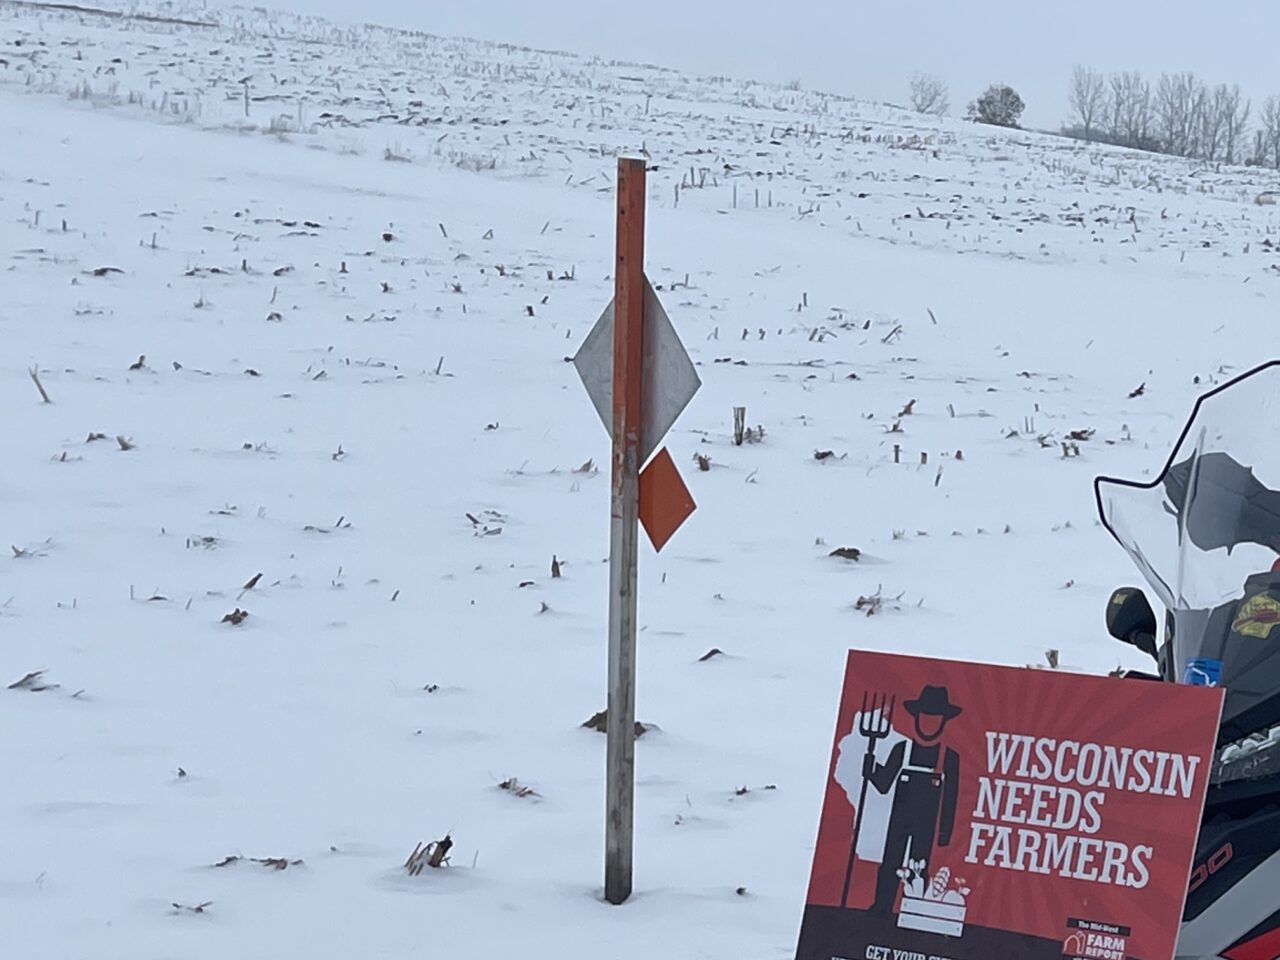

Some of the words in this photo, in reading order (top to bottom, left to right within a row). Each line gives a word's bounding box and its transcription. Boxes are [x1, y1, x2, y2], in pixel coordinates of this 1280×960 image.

[985, 731, 1201, 798] WISCONSIN
[972, 776, 1105, 834] NEEDS
[964, 821, 1153, 889] FARMERS
[1078, 920, 1090, 929] The
[1086, 933, 1125, 951] FARM
[1085, 947, 1124, 960] REPORT
